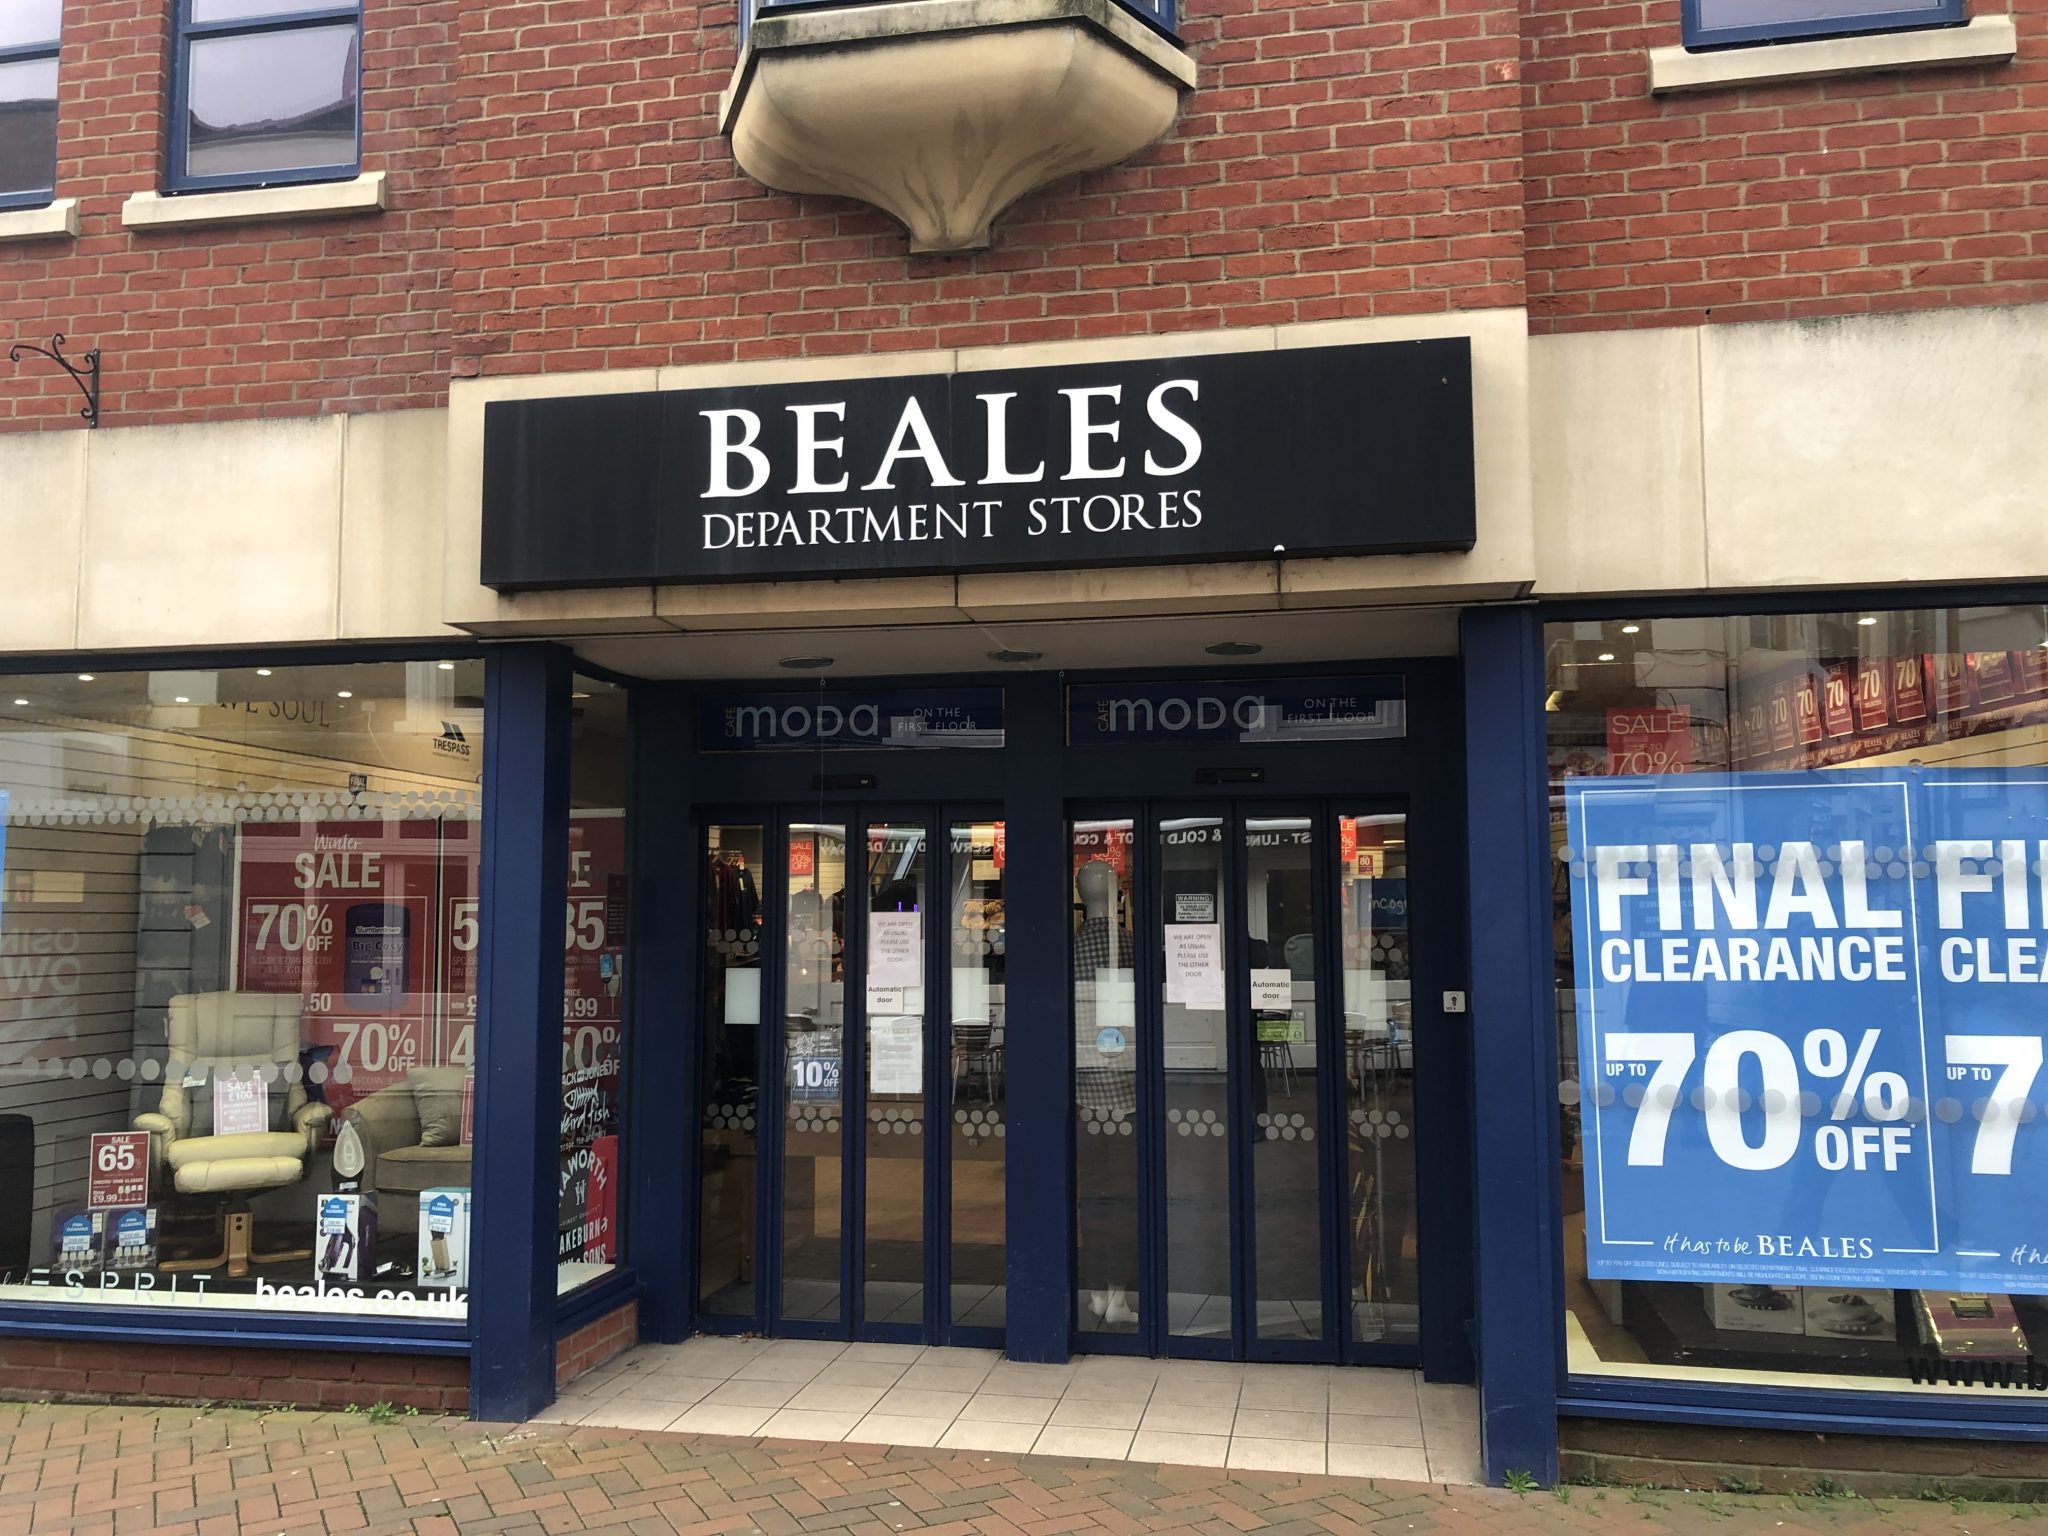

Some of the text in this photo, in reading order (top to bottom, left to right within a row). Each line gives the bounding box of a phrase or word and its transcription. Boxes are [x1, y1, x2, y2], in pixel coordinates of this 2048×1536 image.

[699, 378, 1202, 499] BEALES
[702, 490, 1202, 550] DEPARTMENT STORES
[1860, 669, 1880, 700] 70
[1896, 658, 1917, 690] 70
[1304, 697, 1357, 709] ON THE
[1797, 688, 1813, 717] 70
[1826, 679, 1844, 709] 70
[898, 719, 977, 733] FIRST FLOOR
[913, 707, 961, 719] ON THE
[1287, 710, 1377, 725] FIRST FLOOR
[1612, 712, 1684, 735] SALE
[432, 737, 472, 756] TRESPASS
[1611, 751, 1684, 776] 70%
[314, 833, 362, 851] Winter
[790, 842, 812, 851] SALE
[294, 852, 381, 889] SALE
[790, 853, 811, 863] 70%
[792, 861, 809, 870] OFF
[1595, 839, 1903, 932] FINAL
[1935, 839, 2048, 931] FI
[251, 903, 333, 952] 70% OFF
[1600, 935, 1907, 983] CLEARANCE
[1262, 992, 1280, 1000] door
[333, 1022, 417, 1072] 70%
[793, 1061, 839, 1087] 10% OFF
[1605, 1063, 1647, 1077] UP TO
[1946, 1067, 1992, 1081] UP TO
[1604, 1028, 1910, 1171] 70%
[1944, 1034, 2044, 1175] 7
[111, 1135, 131, 1144] SALE
[1663, 1232, 1874, 1259] It has to be BEALES
[2011, 1244, 2028, 1266] It
[31, 1267, 212, 1304] ESPRIT
[256, 1276, 468, 1313] beales.co.uk
